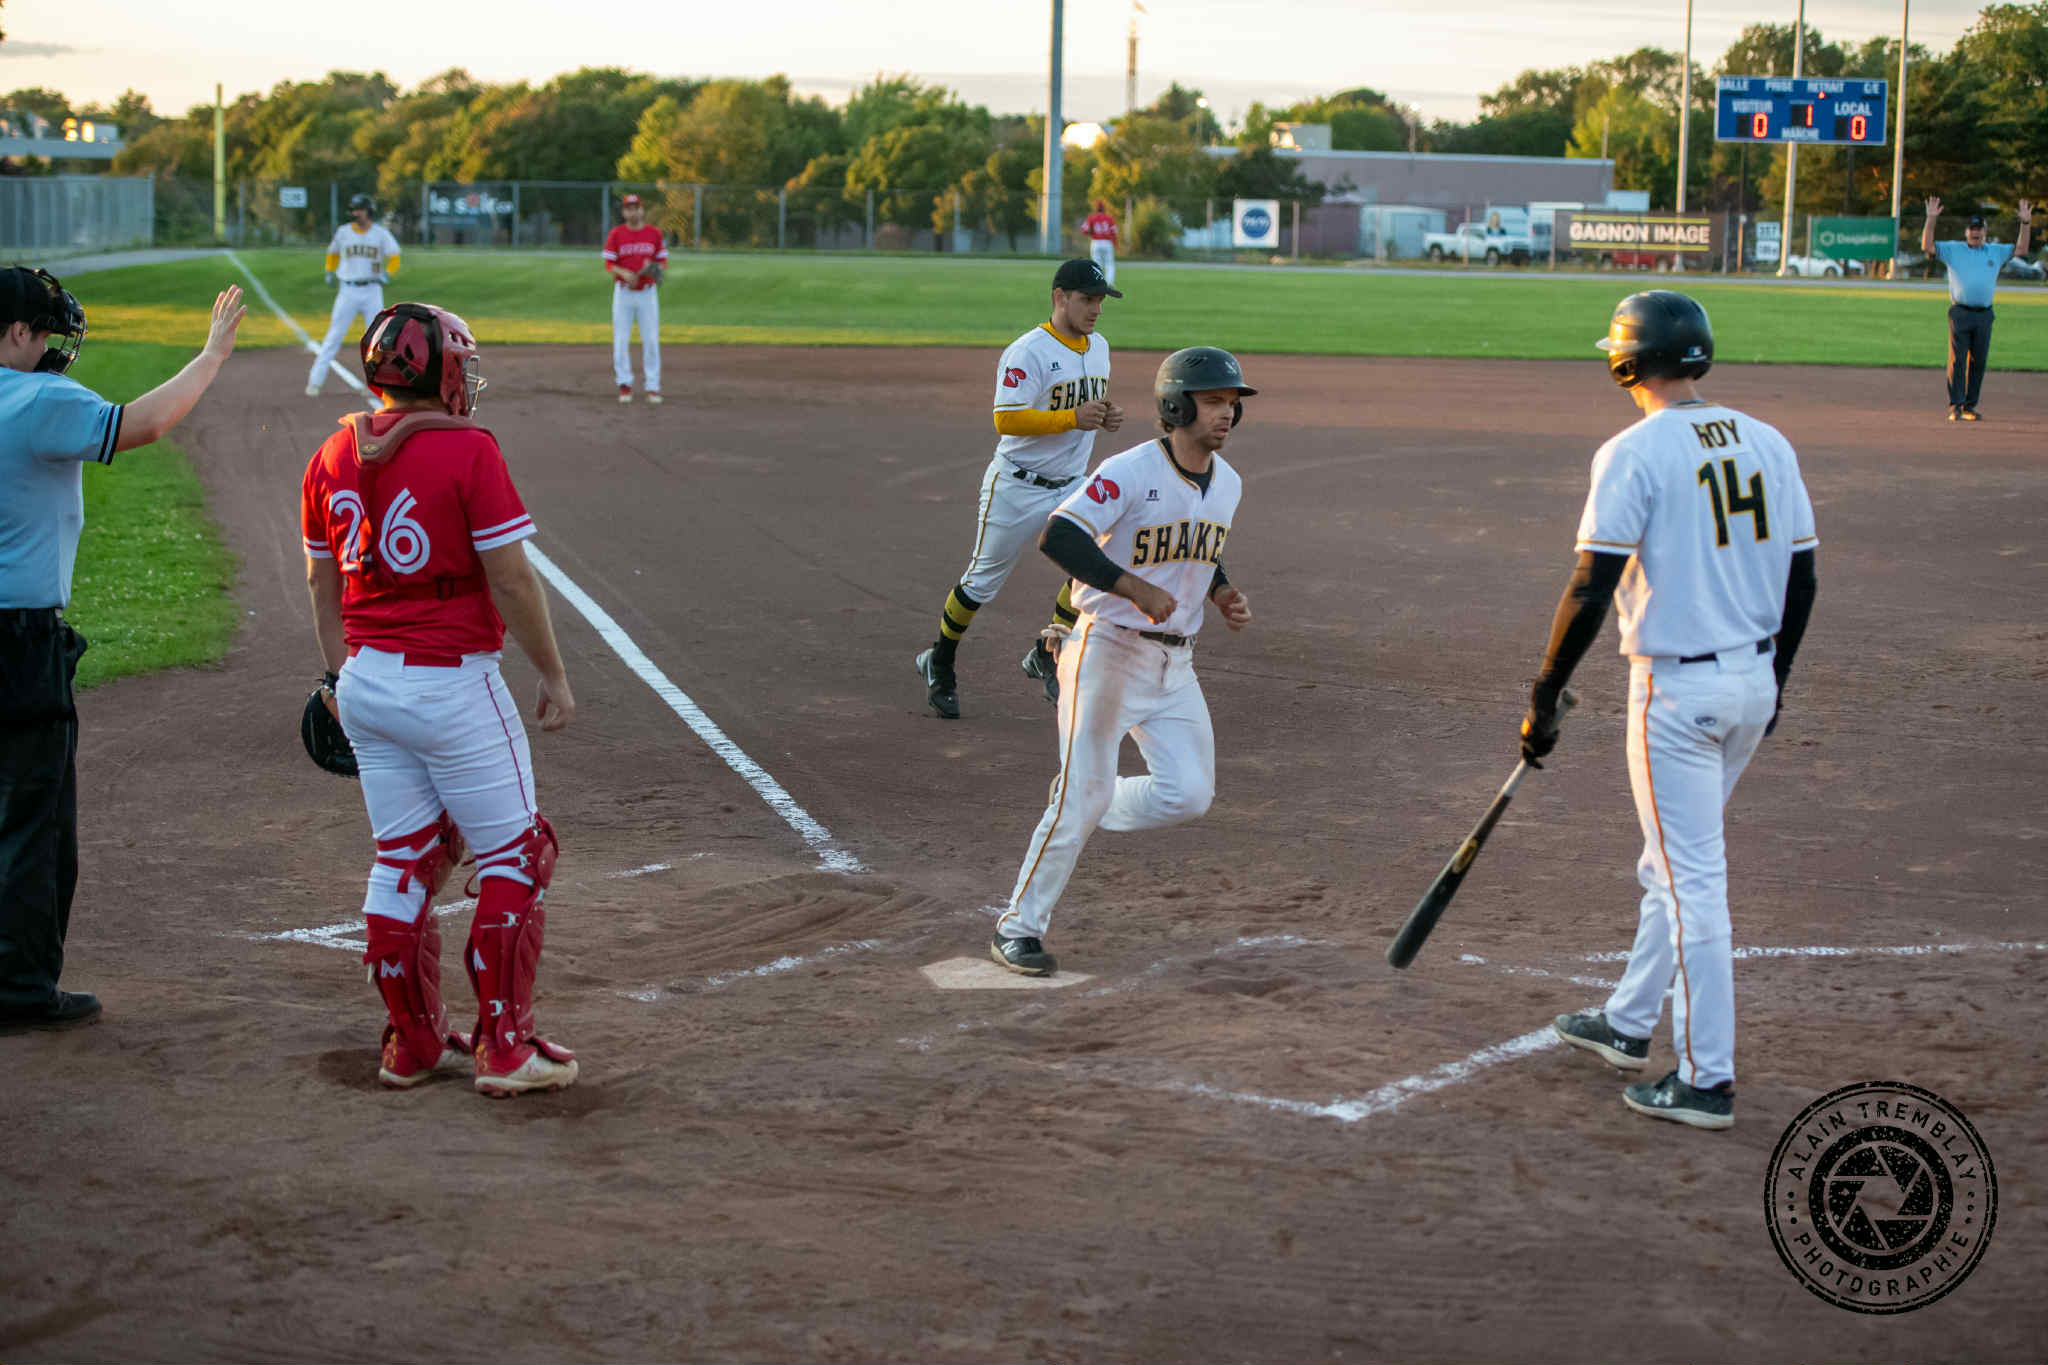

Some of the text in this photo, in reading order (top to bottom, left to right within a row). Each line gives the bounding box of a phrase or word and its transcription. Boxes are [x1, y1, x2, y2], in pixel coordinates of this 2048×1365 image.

[1834, 102, 1872, 116] LOCAL
[1753, 112, 1768, 138] 0
[1851, 115, 1866, 140] 0
[1570, 222, 1711, 244] GAGNON IMAGE
[1691, 418, 1741, 449] ROY
[1697, 457, 1770, 548] 14
[329, 487, 430, 574] 26
